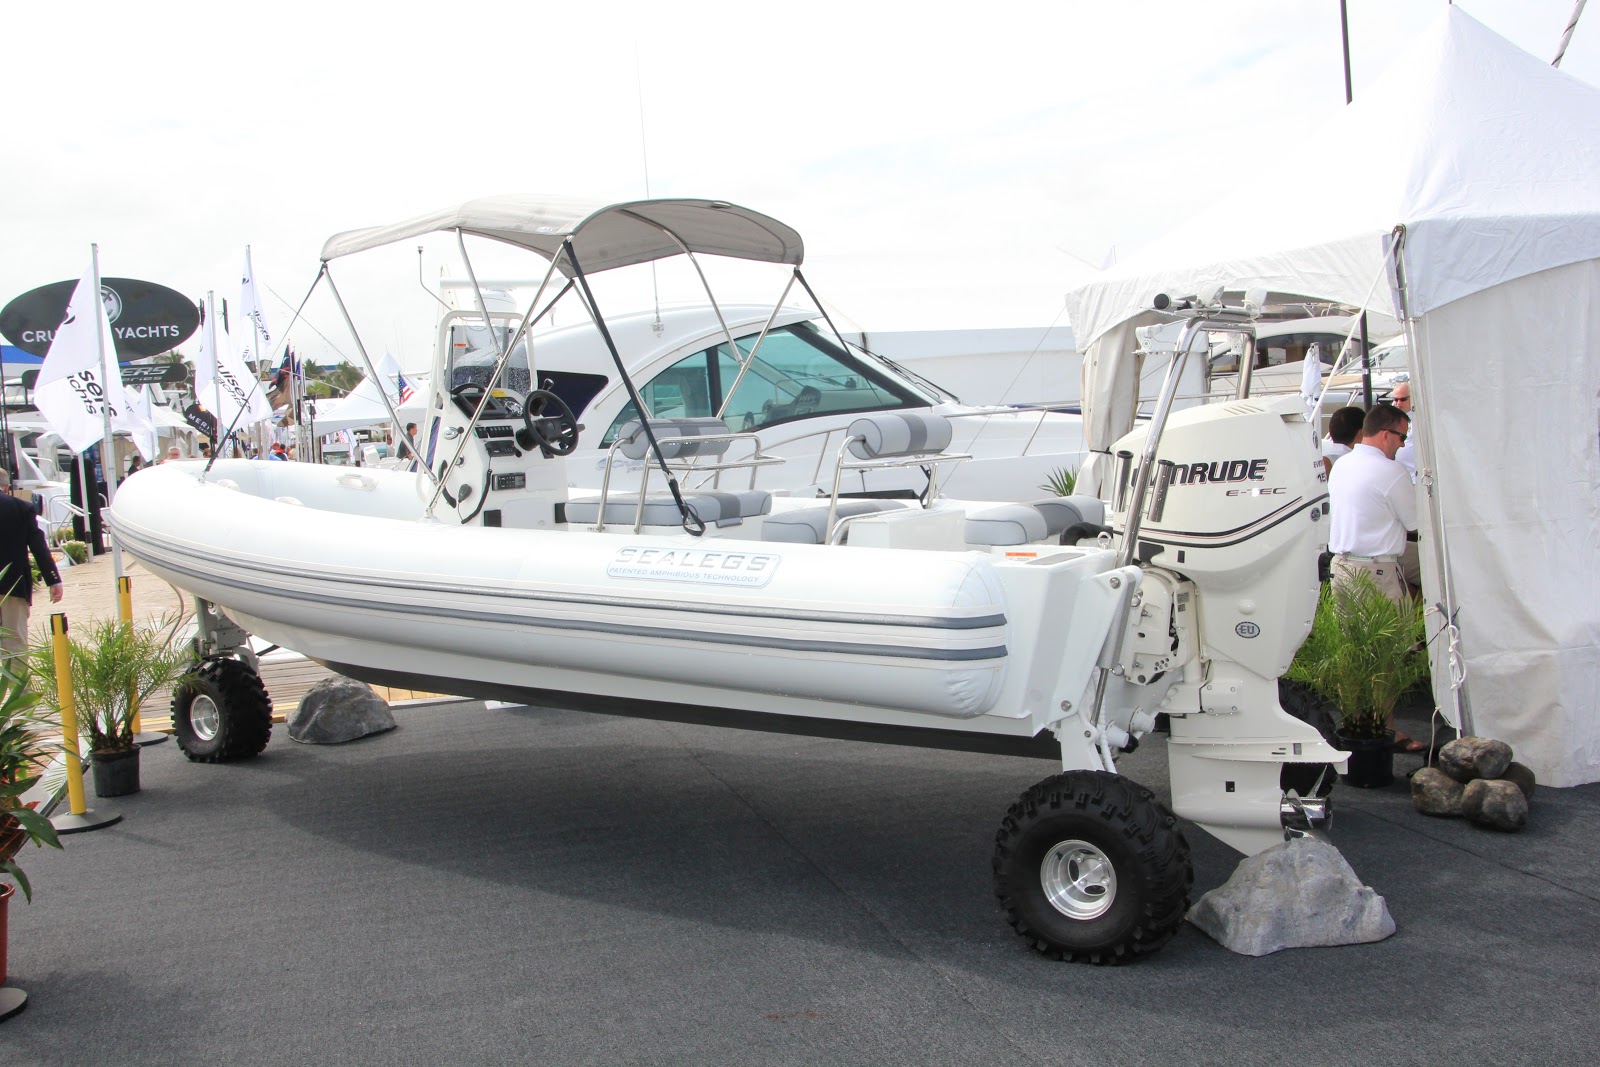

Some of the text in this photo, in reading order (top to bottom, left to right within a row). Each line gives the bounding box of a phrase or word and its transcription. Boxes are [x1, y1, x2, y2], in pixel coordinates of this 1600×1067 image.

[115, 325, 180, 339] YACHTS
[1131, 459, 1269, 488] NRUDE
[615, 548, 770, 572] SEALEGS
[609, 566, 760, 584] PATENTED AMPHIBIOUS TECHNOLOGY
